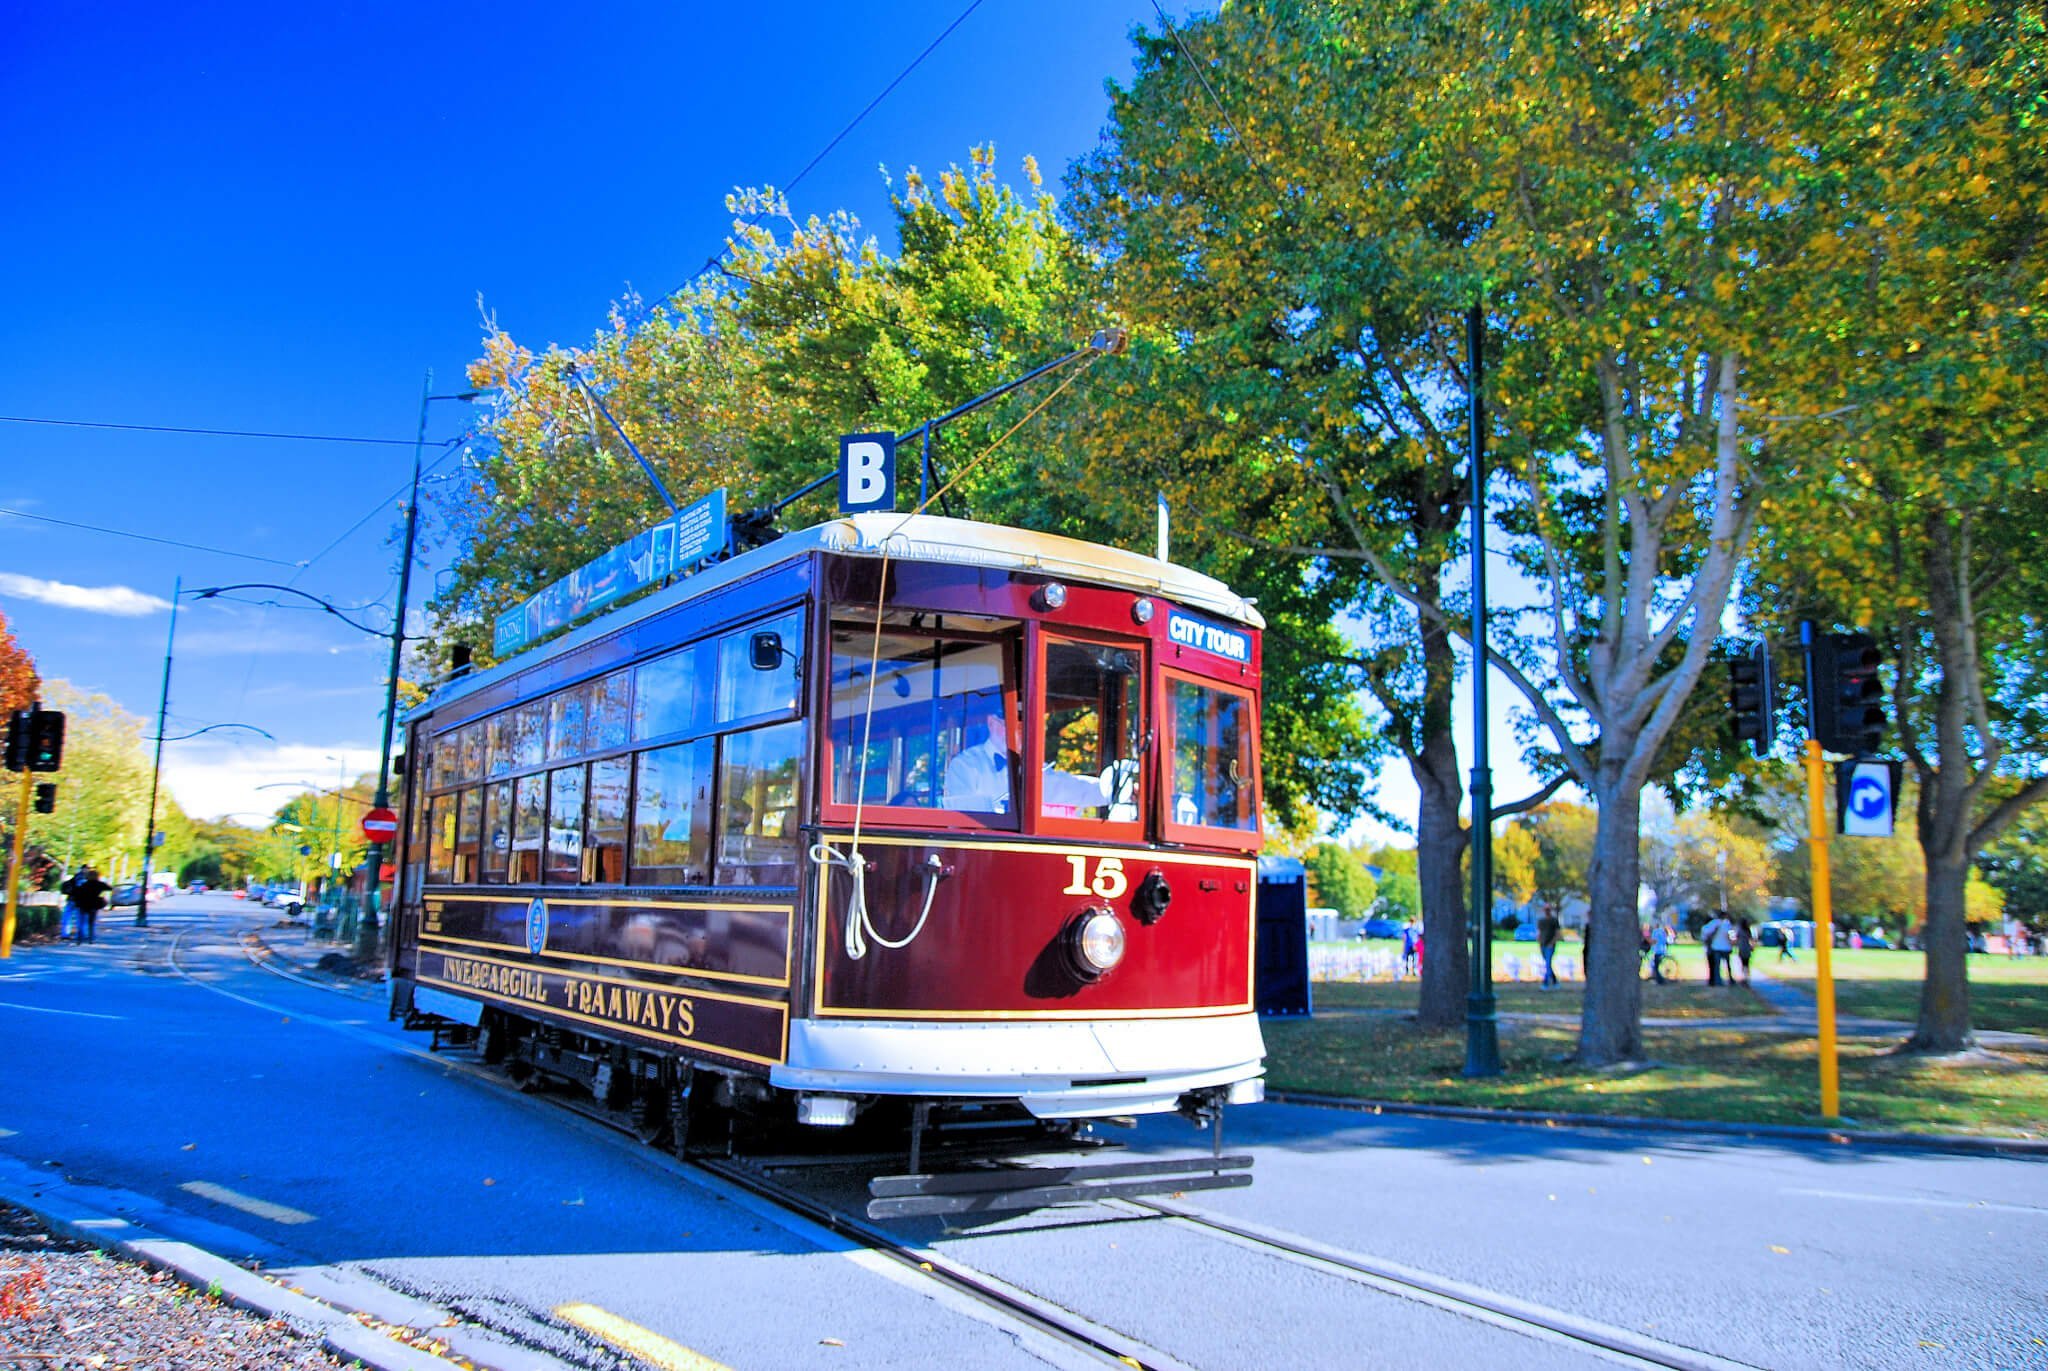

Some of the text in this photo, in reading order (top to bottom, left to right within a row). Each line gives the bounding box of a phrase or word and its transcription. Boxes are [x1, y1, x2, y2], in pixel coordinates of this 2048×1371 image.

[848, 442, 886, 504] B
[1169, 615, 1245, 660] CITY TOUR
[1063, 855, 1128, 899] 15
[442, 957, 695, 1037] INVERCARGILL TRAMWAYS
